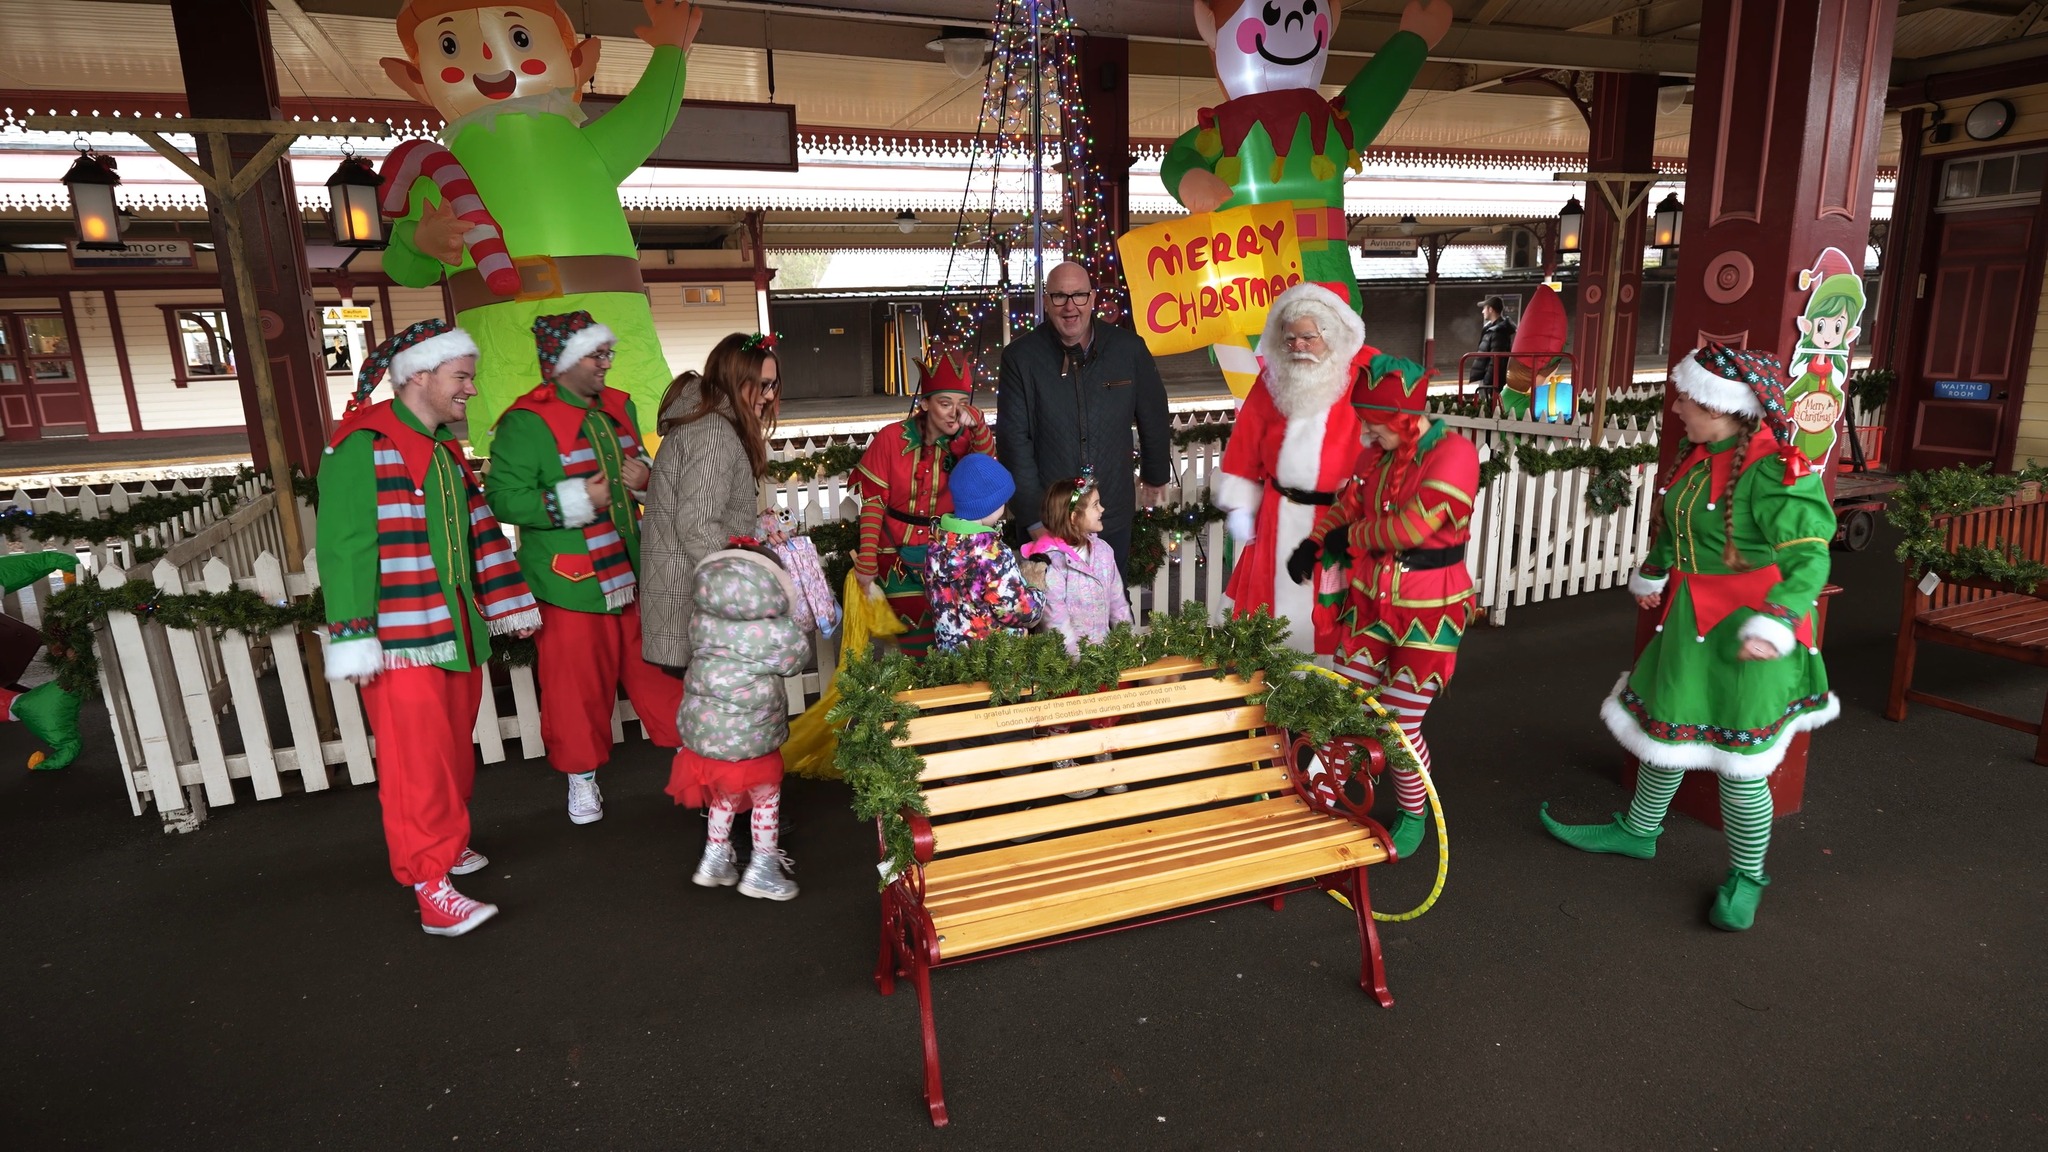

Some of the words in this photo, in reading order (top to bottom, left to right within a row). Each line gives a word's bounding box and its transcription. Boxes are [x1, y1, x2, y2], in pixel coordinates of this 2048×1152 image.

[1147, 220, 1285, 281] MERRY
[1941, 383, 1983, 391] WAITING
[1800, 410, 1831, 423] Christmas
[1804, 399, 1825, 413] Merry
[983, 708, 1012, 720] grateful
[1013, 704, 1042, 714] memory
[1043, 702, 1051, 710] of
[1053, 701, 1065, 709] the
[1066, 699, 1082, 707] men
[1082, 697, 1096, 705] and
[1098, 693, 1122, 702] women
[1139, 687, 1163, 696] worked
[996, 718, 1024, 728] London
[1025, 713, 1054, 724] Midland
[1055, 710, 1084, 719] Scottish
[1099, 703, 1121, 713] during
[1136, 699, 1152, 707] after
